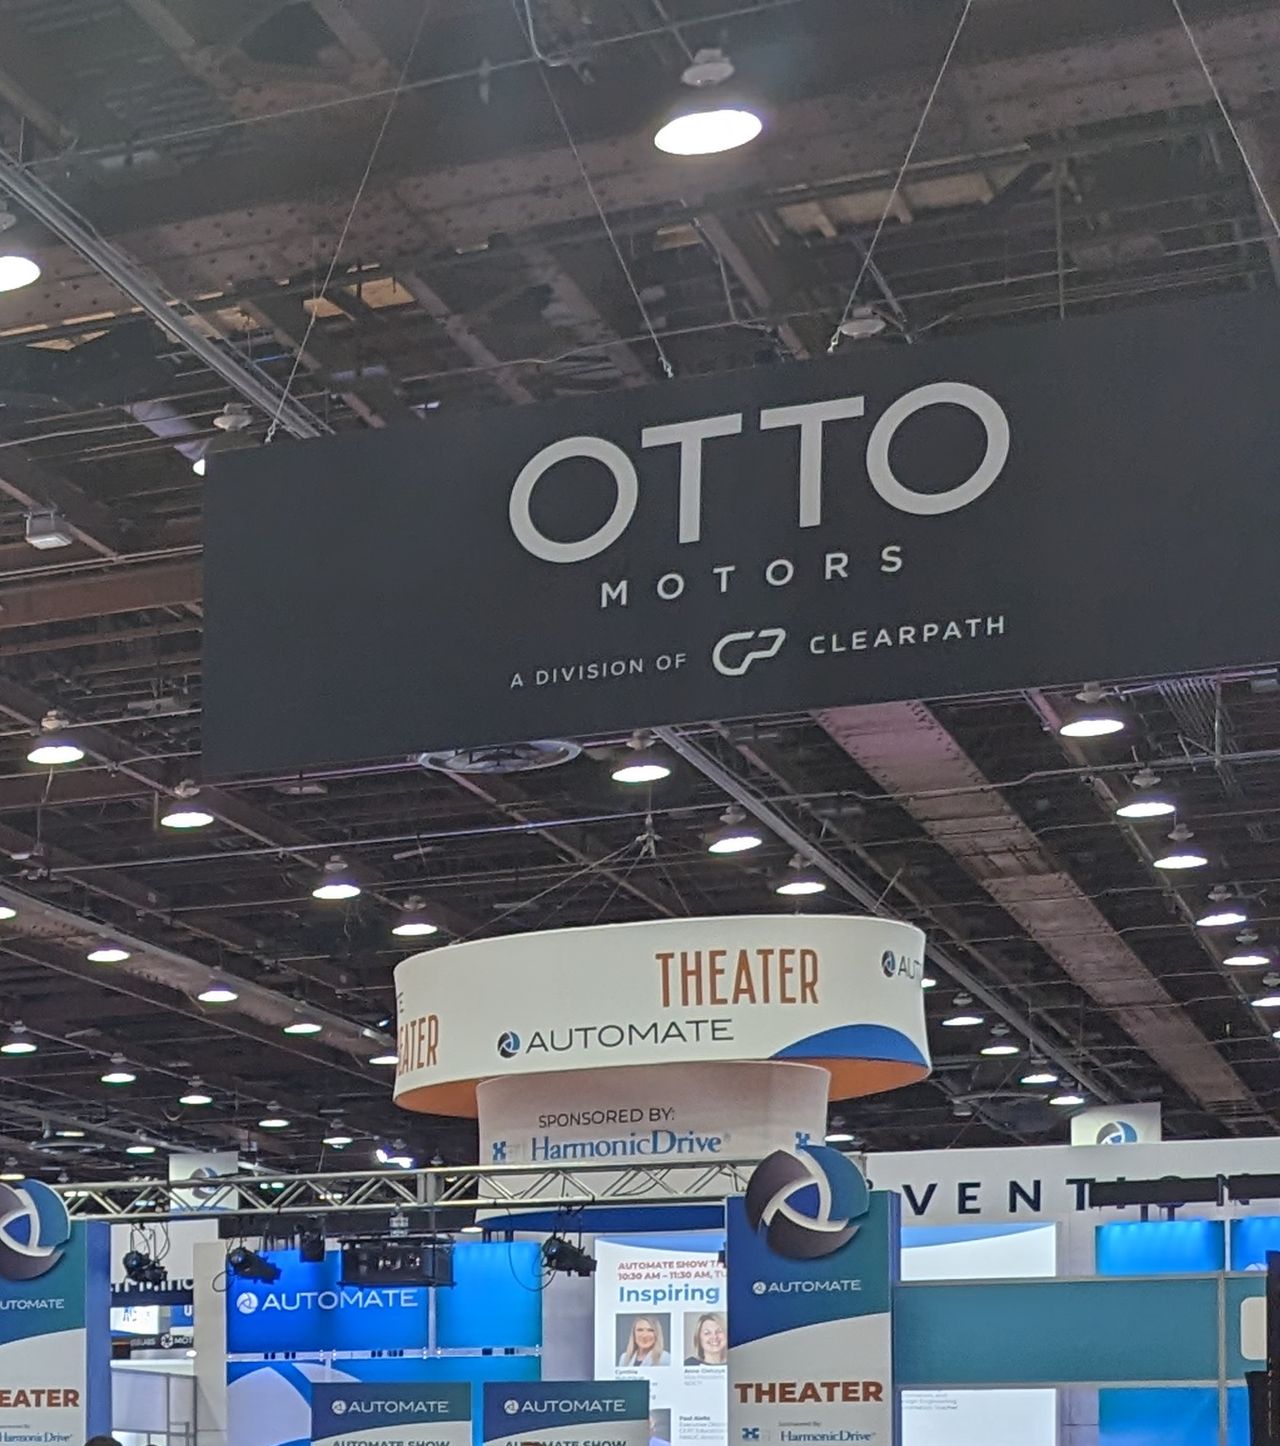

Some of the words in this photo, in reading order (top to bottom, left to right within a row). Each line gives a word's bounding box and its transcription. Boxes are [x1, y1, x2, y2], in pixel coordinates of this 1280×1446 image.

[509, 381, 1011, 563] OTTO
[600, 545, 904, 609] MOTORS
[509, 673, 525, 689] A
[535, 658, 644, 687] DIVISION
[655, 652, 687, 672] OF
[810, 615, 1007, 656] CLEARPATH
[655, 948, 819, 1008] THEATER
[526, 1018, 734, 1055] AUTOMATE
[538, 1109, 645, 1129] SPONSORED
[648, 1107, 675, 1123] BY:
[618, 1261, 674, 1271] AUTOMATE
[676, 1260, 708, 1269] SHOW
[618, 1272, 643, 1281] 10:30
[644, 1272, 661, 1280] AM
[670, 1271, 692, 1279] 11:30
[693, 1271, 713, 1280] AM,
[619, 1284, 720, 1305] Inspiring
[768, 1279, 862, 1293] AUTOMATE
[262, 1289, 418, 1311] AUTOMATE
[734, 1381, 883, 1403] THEATER
[349, 1400, 449, 1413] AUTOMATE
[522, 1399, 626, 1413] AUTOMATE
